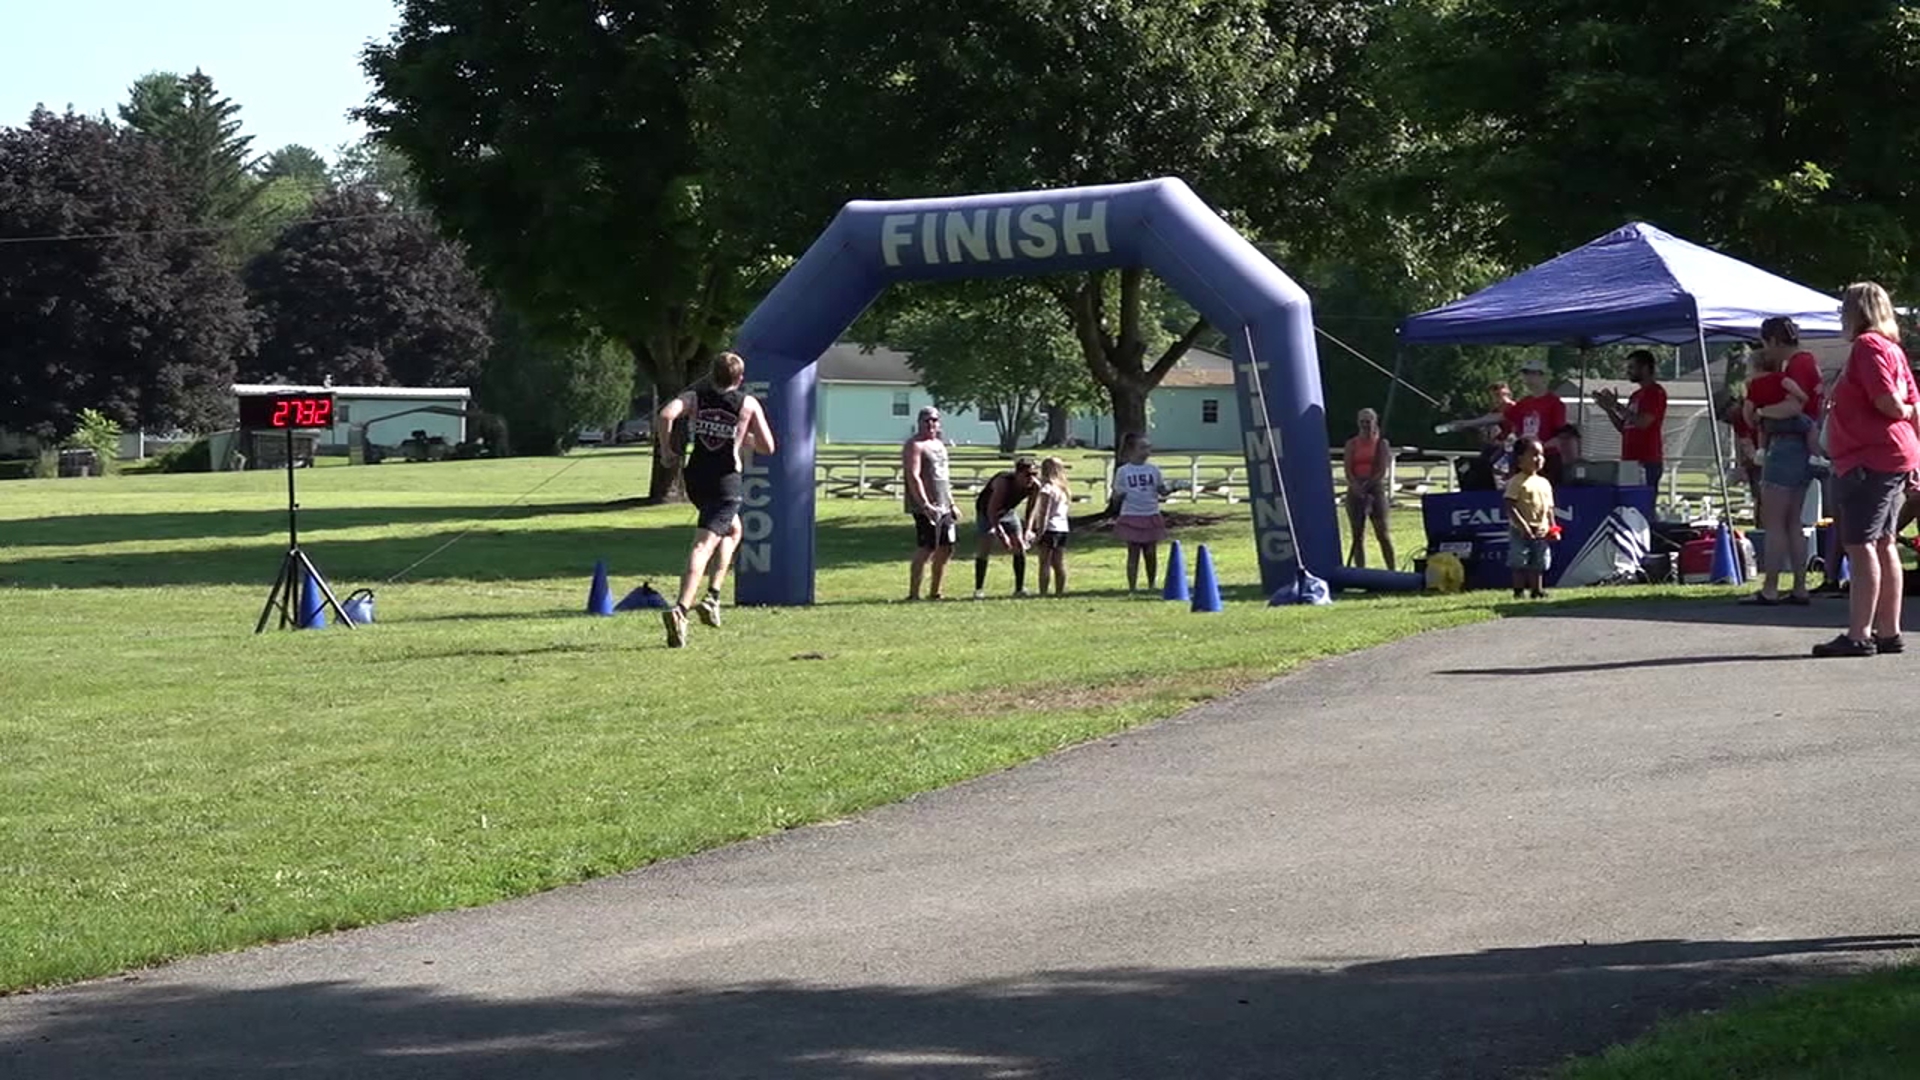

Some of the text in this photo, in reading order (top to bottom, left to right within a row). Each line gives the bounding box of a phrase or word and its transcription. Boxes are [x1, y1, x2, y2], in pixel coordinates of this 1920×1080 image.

[882, 201, 1111, 266] FINISH
[741, 381, 774, 573] FLCON
[1127, 474, 1155, 488] USA
[1238, 361, 1295, 562] TIMING
[1452, 505, 1573, 527] FALN
